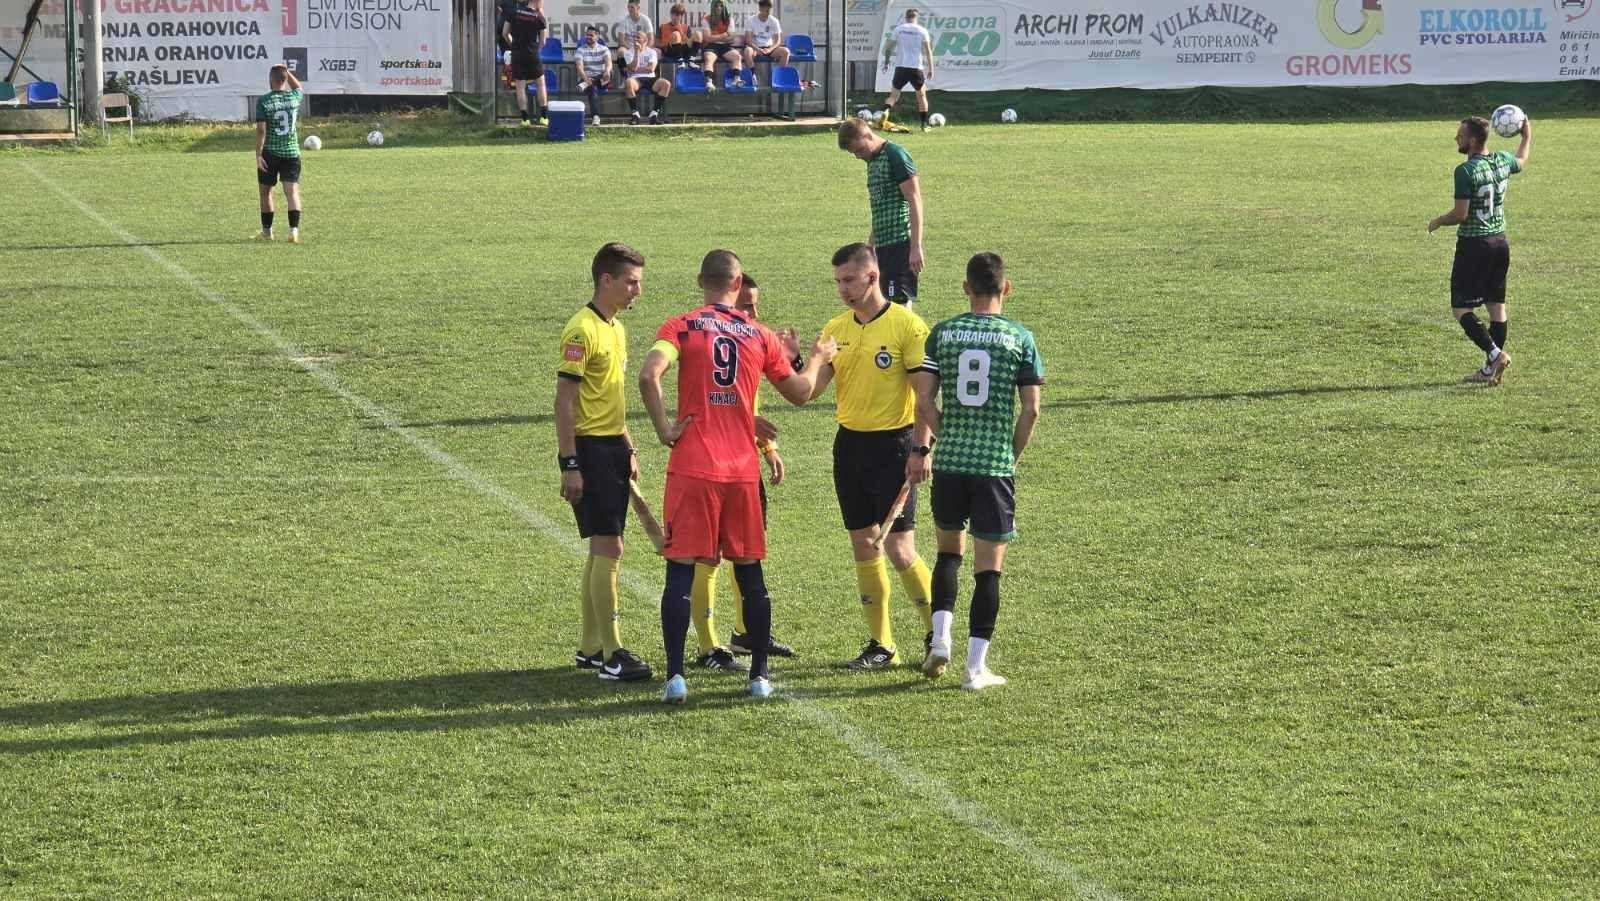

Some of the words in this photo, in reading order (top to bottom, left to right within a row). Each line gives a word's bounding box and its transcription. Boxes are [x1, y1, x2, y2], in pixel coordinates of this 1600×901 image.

[344, 0, 440, 11] MEDICAL
[308, 12, 401, 30] DIVISION
[1014, 14, 1079, 38] ARCHI
[1085, 14, 1143, 37] PROM
[1149, 3, 1279, 46] VULKANIZER
[1418, 8, 1547, 32] ELKOROLL
[147, 21, 262, 37] ORAHOVICA
[1173, 35, 1260, 48] AUTOPRAONA
[1419, 34, 1452, 46] PVC
[1455, 31, 1547, 45] STOLARIJA
[154, 45, 268, 61] ORAHOVICA
[1176, 52, 1242, 64] SEMPERIT
[1285, 54, 1412, 76] GROMEKS
[1559, 66, 1587, 76] Emir
[126, 66, 220, 85] RAŠLJEVA
[941, 328, 954, 343] NK
[712, 335, 739, 388] 9
[956, 348, 991, 407] 8
